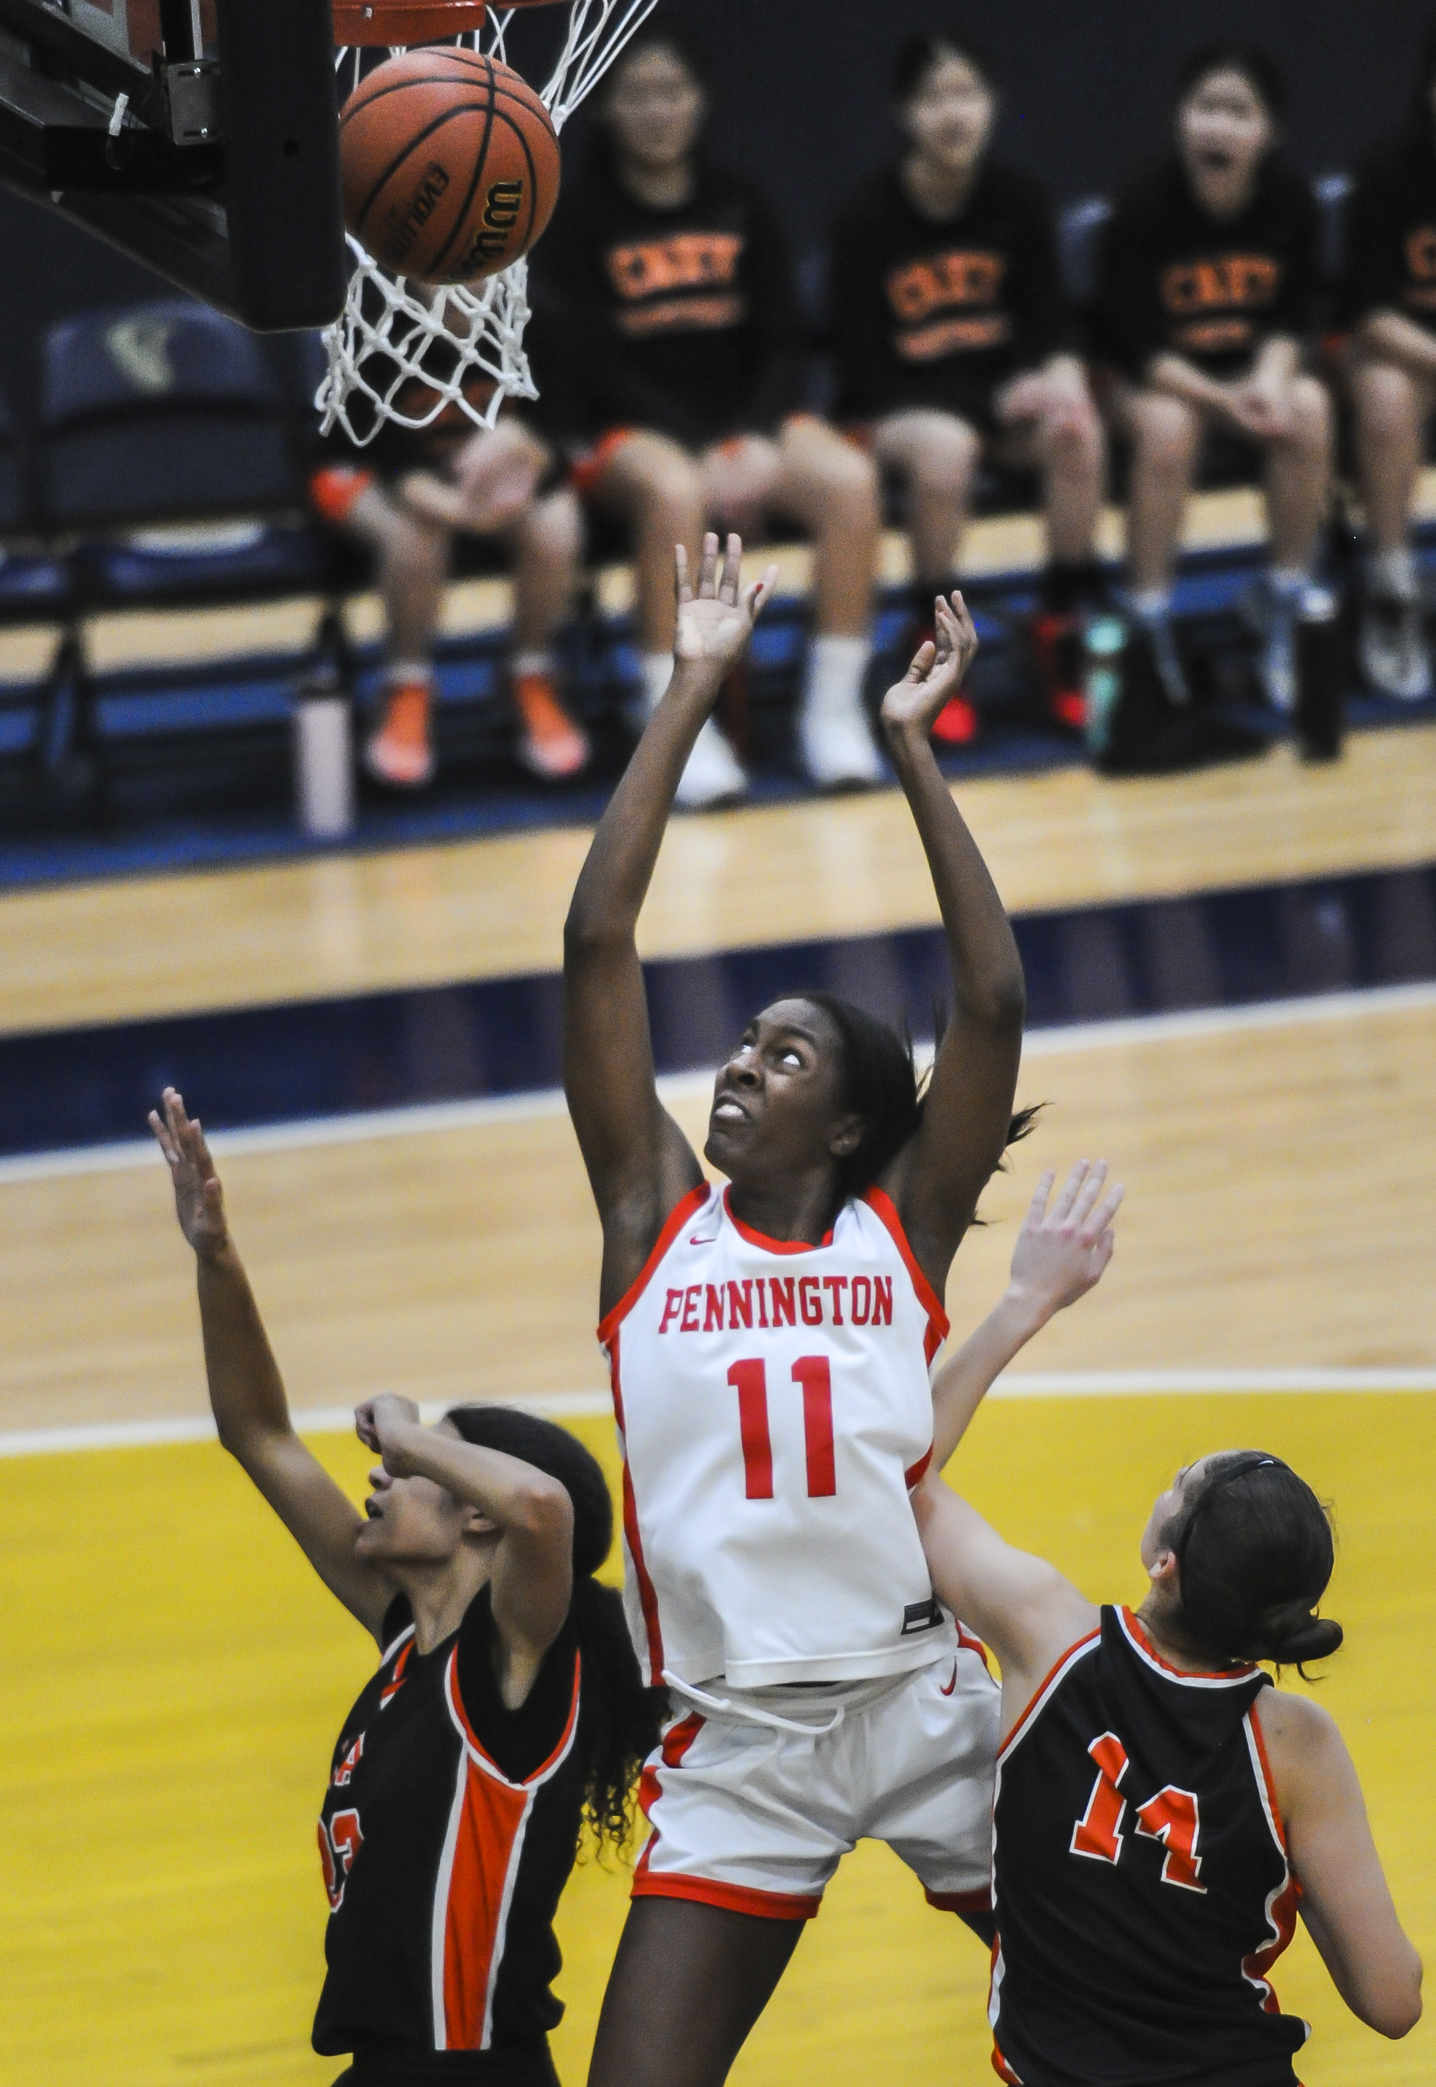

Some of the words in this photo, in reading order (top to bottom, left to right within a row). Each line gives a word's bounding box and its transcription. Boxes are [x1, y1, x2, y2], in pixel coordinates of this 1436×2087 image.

[449, 179, 524, 283] Wil
[658, 1275, 893, 1334] PENNINGTON
[727, 1355, 836, 1499] 11
